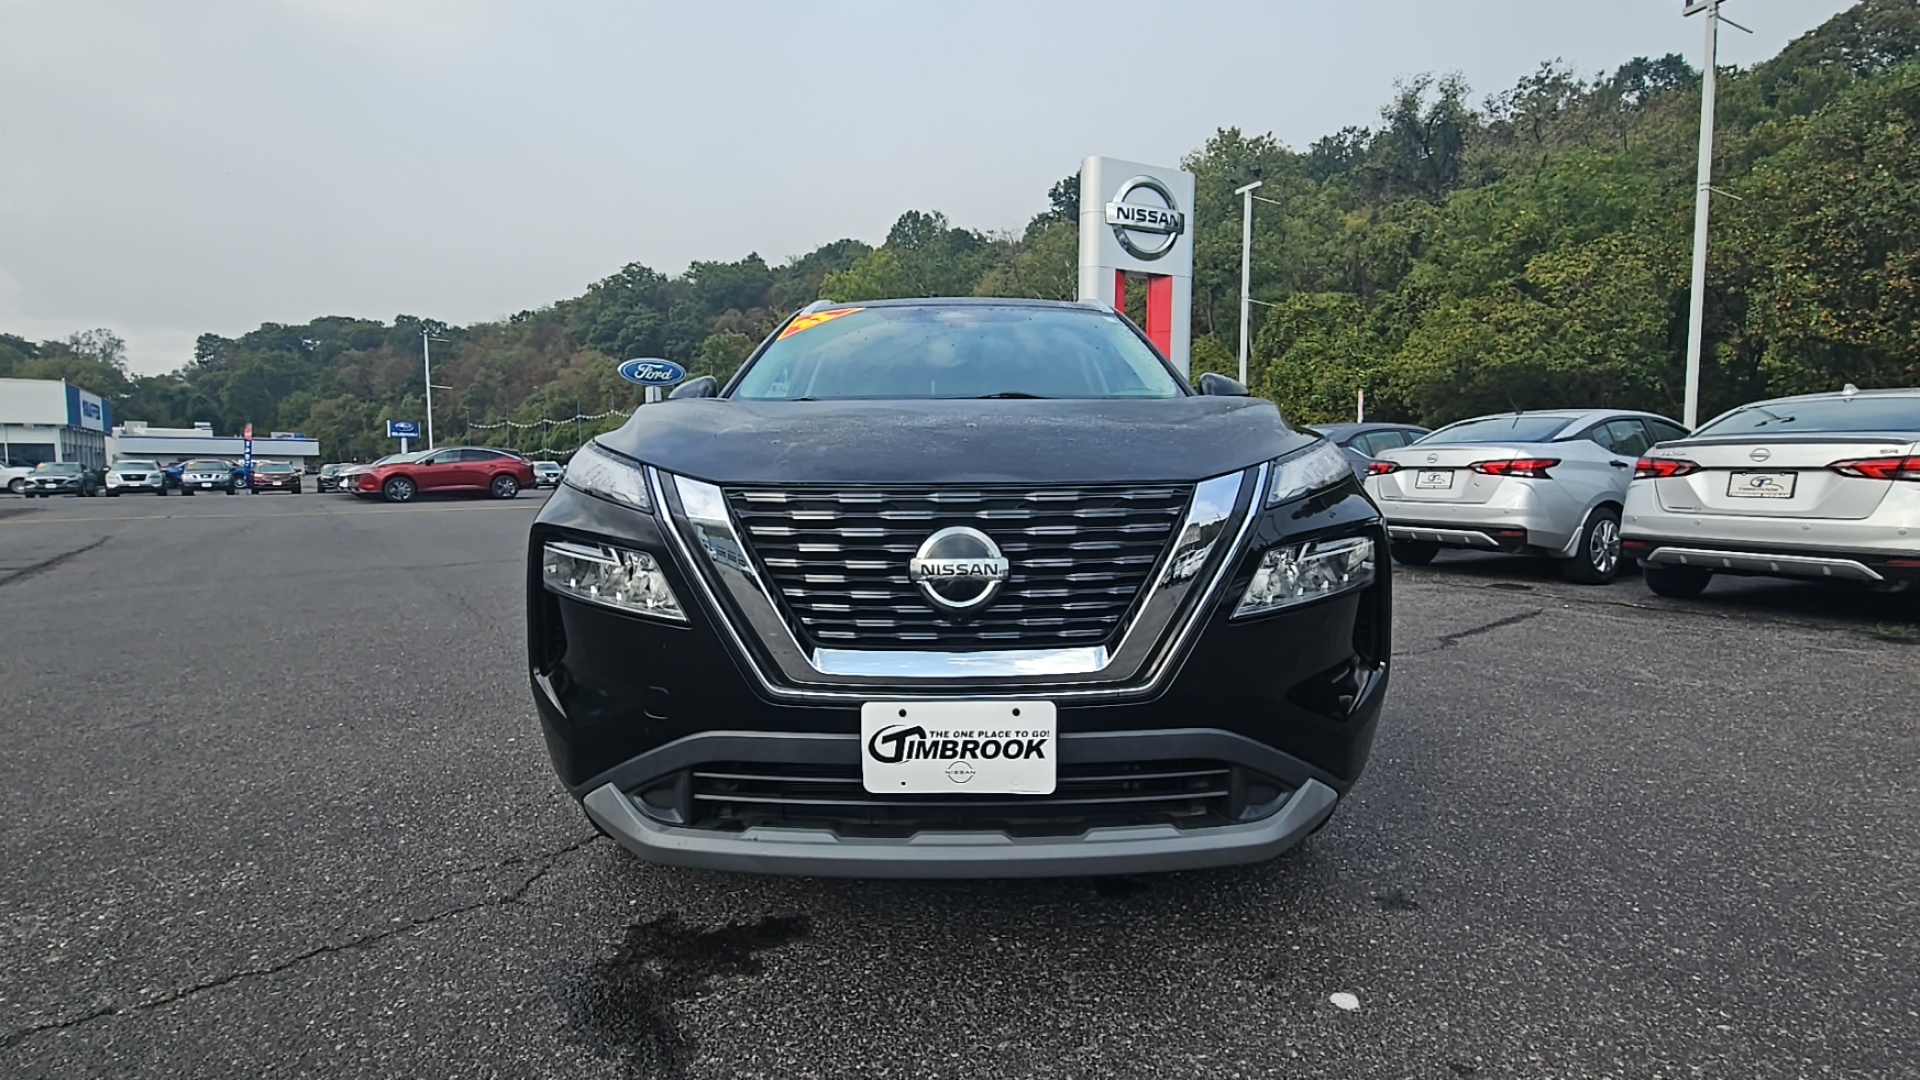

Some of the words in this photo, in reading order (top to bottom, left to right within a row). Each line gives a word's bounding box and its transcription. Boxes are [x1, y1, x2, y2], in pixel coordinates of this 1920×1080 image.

[1116, 206, 1180, 227] NISSAN
[634, 363, 673, 380] Ford
[921, 563, 998, 576] NISSAN
[929, 730, 950, 738] THE
[953, 730, 975, 738] ONE
[978, 730, 1012, 738] PLACE
[1015, 730, 1028, 738] TO
[1032, 730, 1050, 738] GO!
[869, 725, 1049, 763] TIMBROOK
